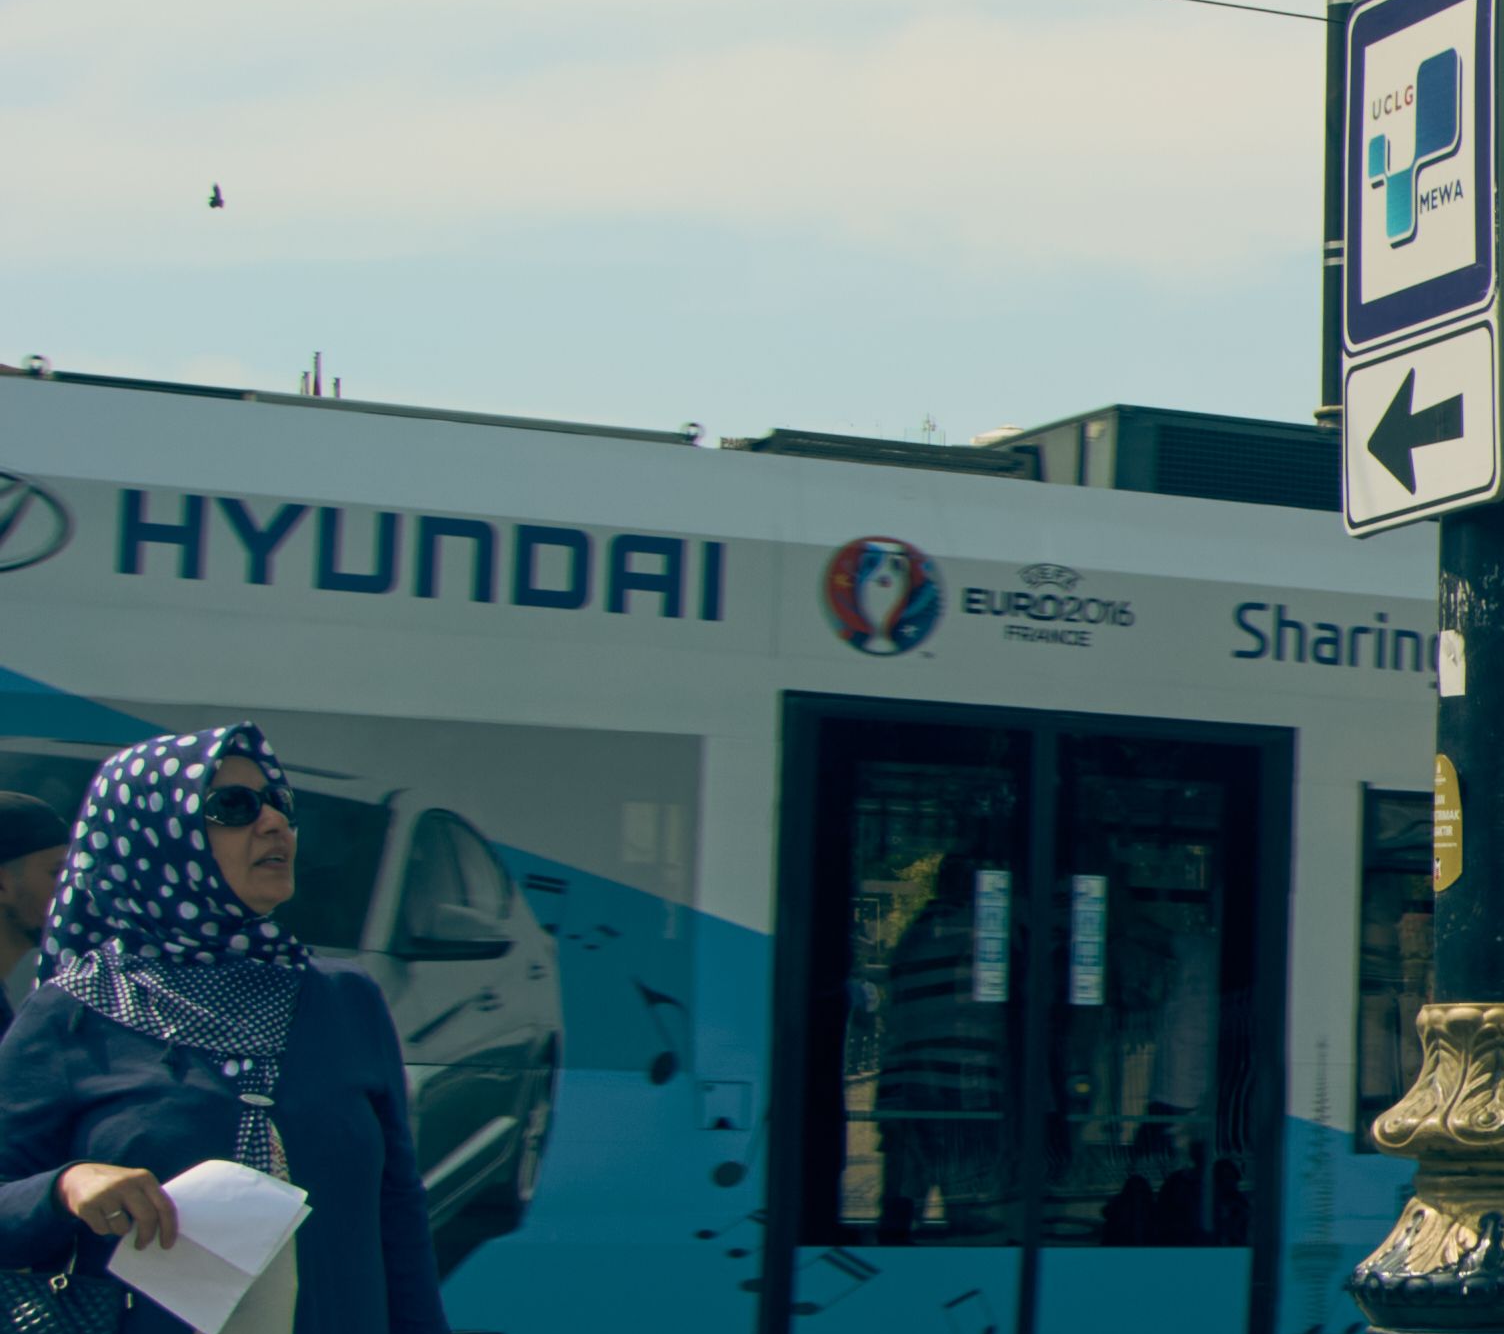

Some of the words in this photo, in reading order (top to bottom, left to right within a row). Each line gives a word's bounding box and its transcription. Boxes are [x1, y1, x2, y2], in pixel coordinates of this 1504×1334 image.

[1372, 84, 1414, 120] UCLG
[1419, 179, 1464, 215] MEWA
[116, 488, 727, 621] HYUNDAI
[1004, 624, 1093, 647] FRANCE
